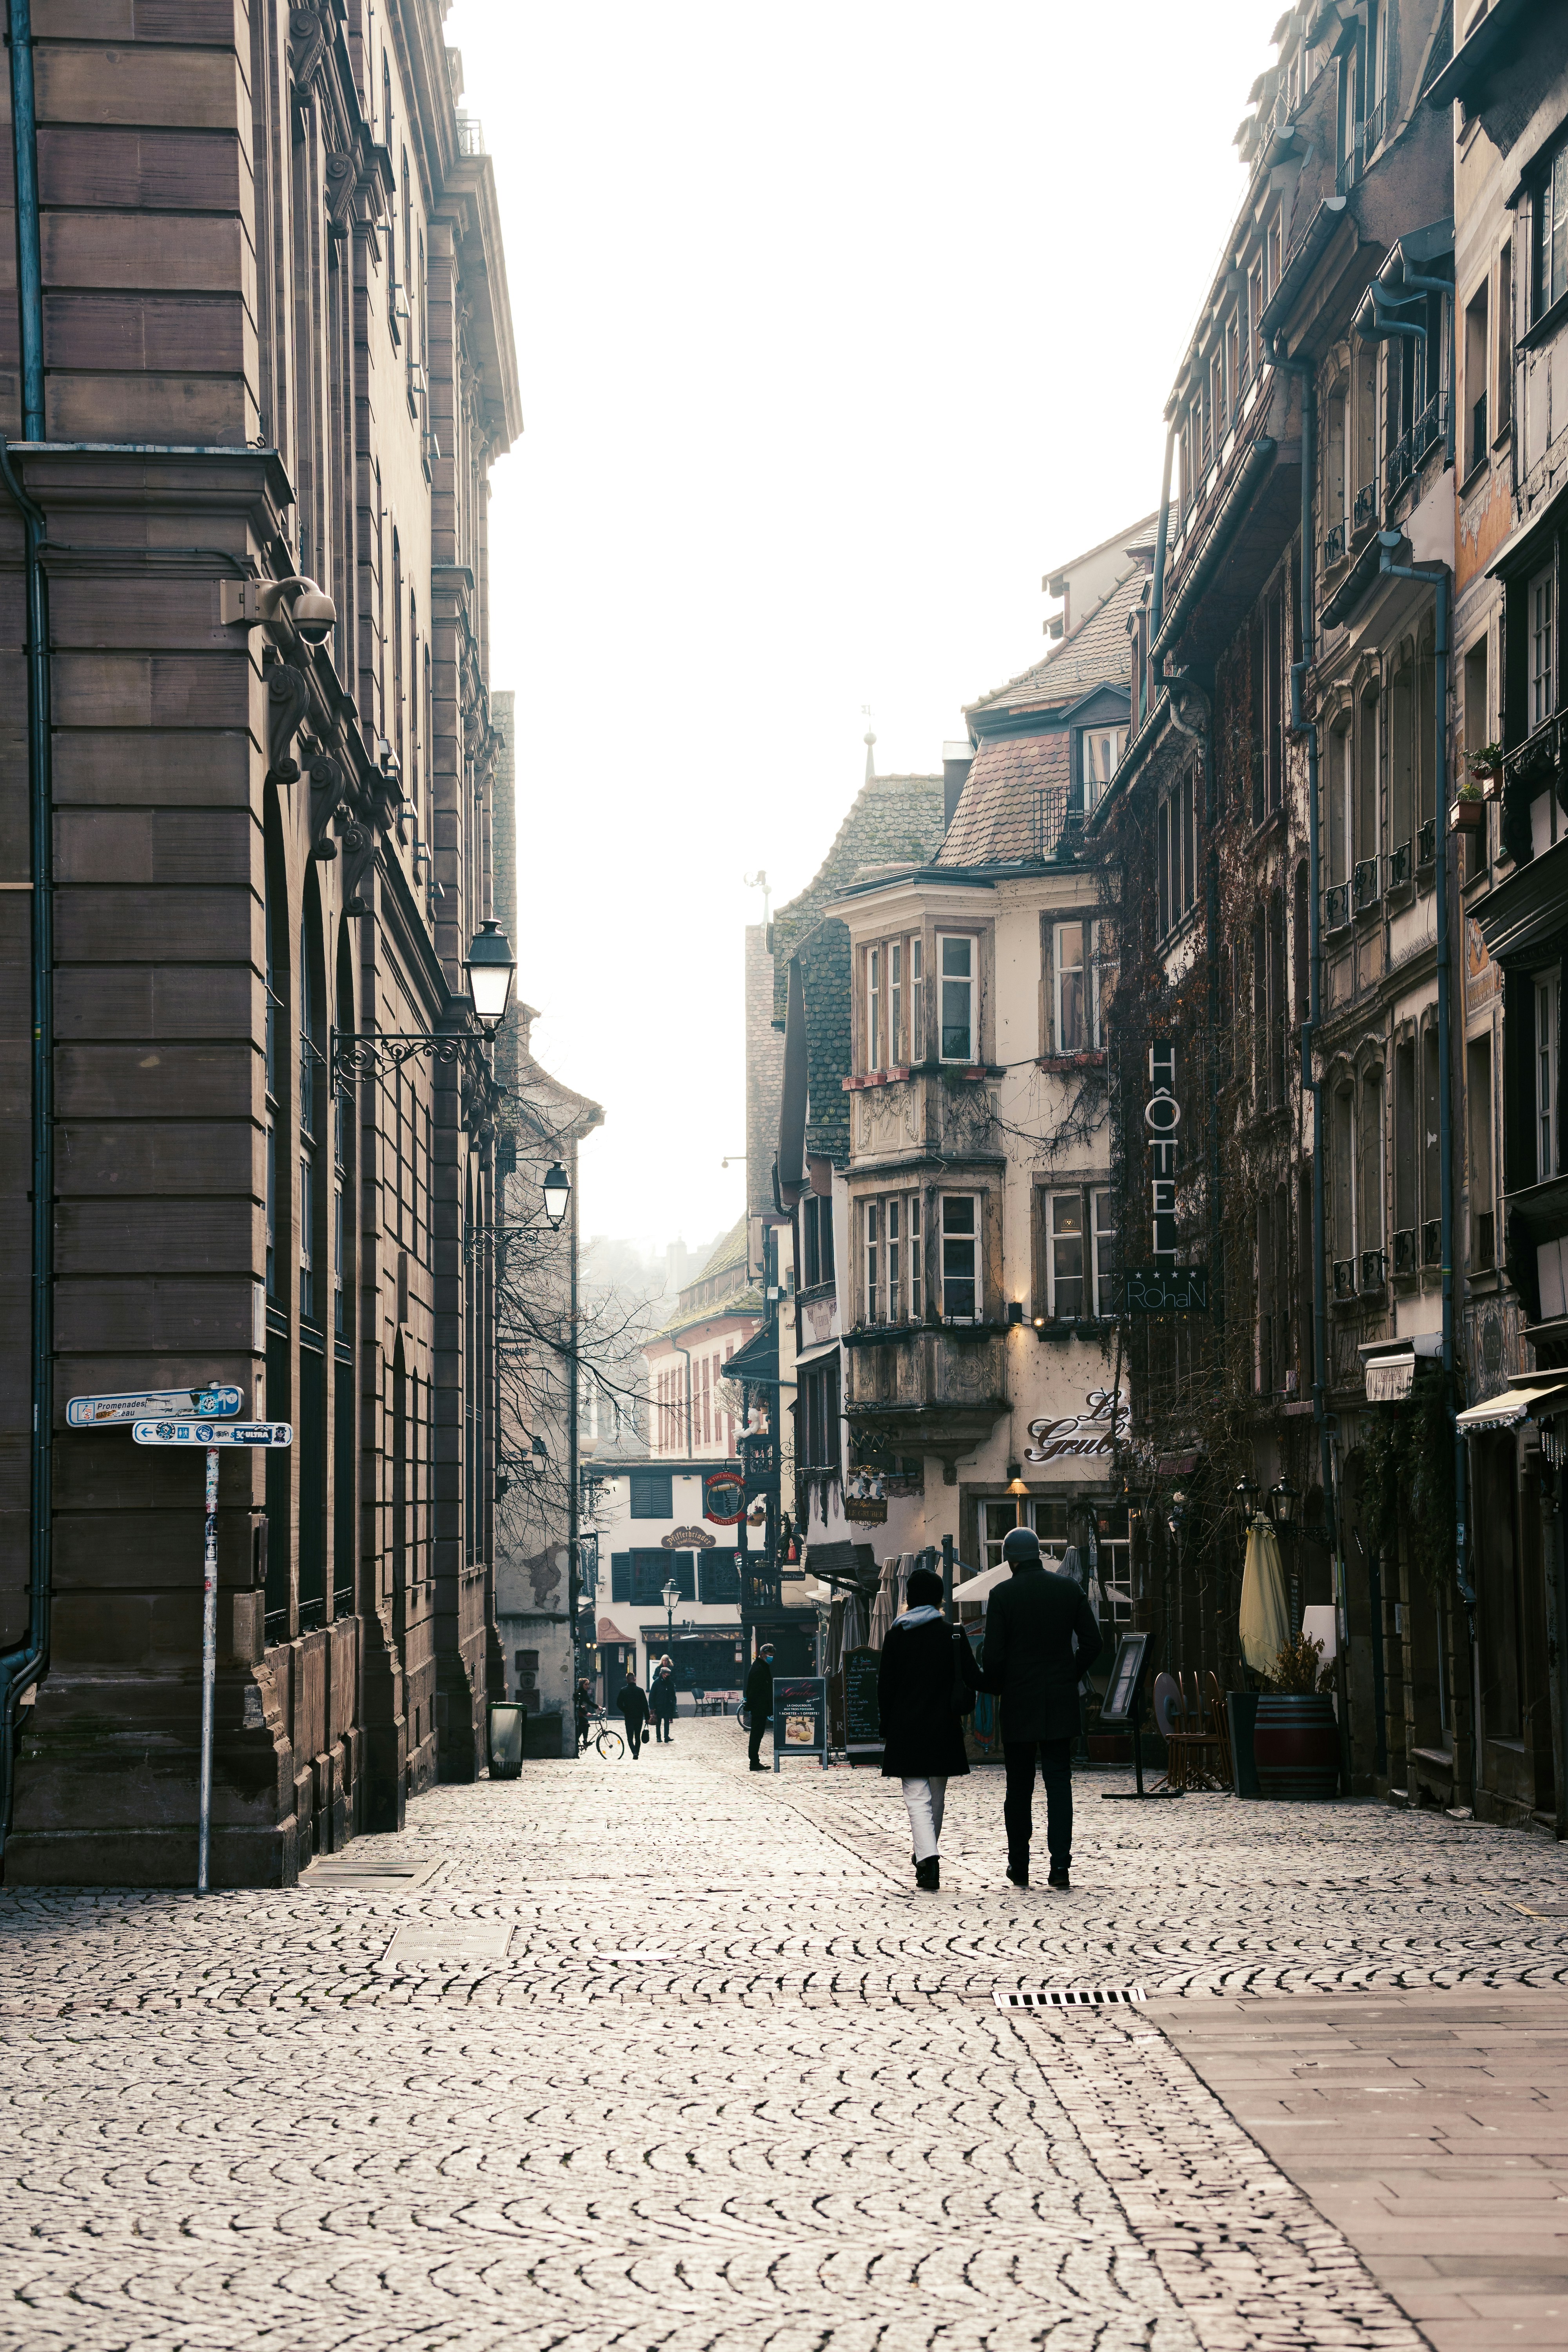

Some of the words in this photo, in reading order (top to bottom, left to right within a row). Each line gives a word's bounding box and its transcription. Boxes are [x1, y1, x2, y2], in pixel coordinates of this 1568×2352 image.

[1145, 1048, 1181, 1254] HÔTEL
[97, 1401, 145, 1410] Promenades
[1077, 1390, 1130, 1421] Le
[1024, 1418, 1132, 1462] Grube
[723, 1474, 744, 1485] BOUCHON
